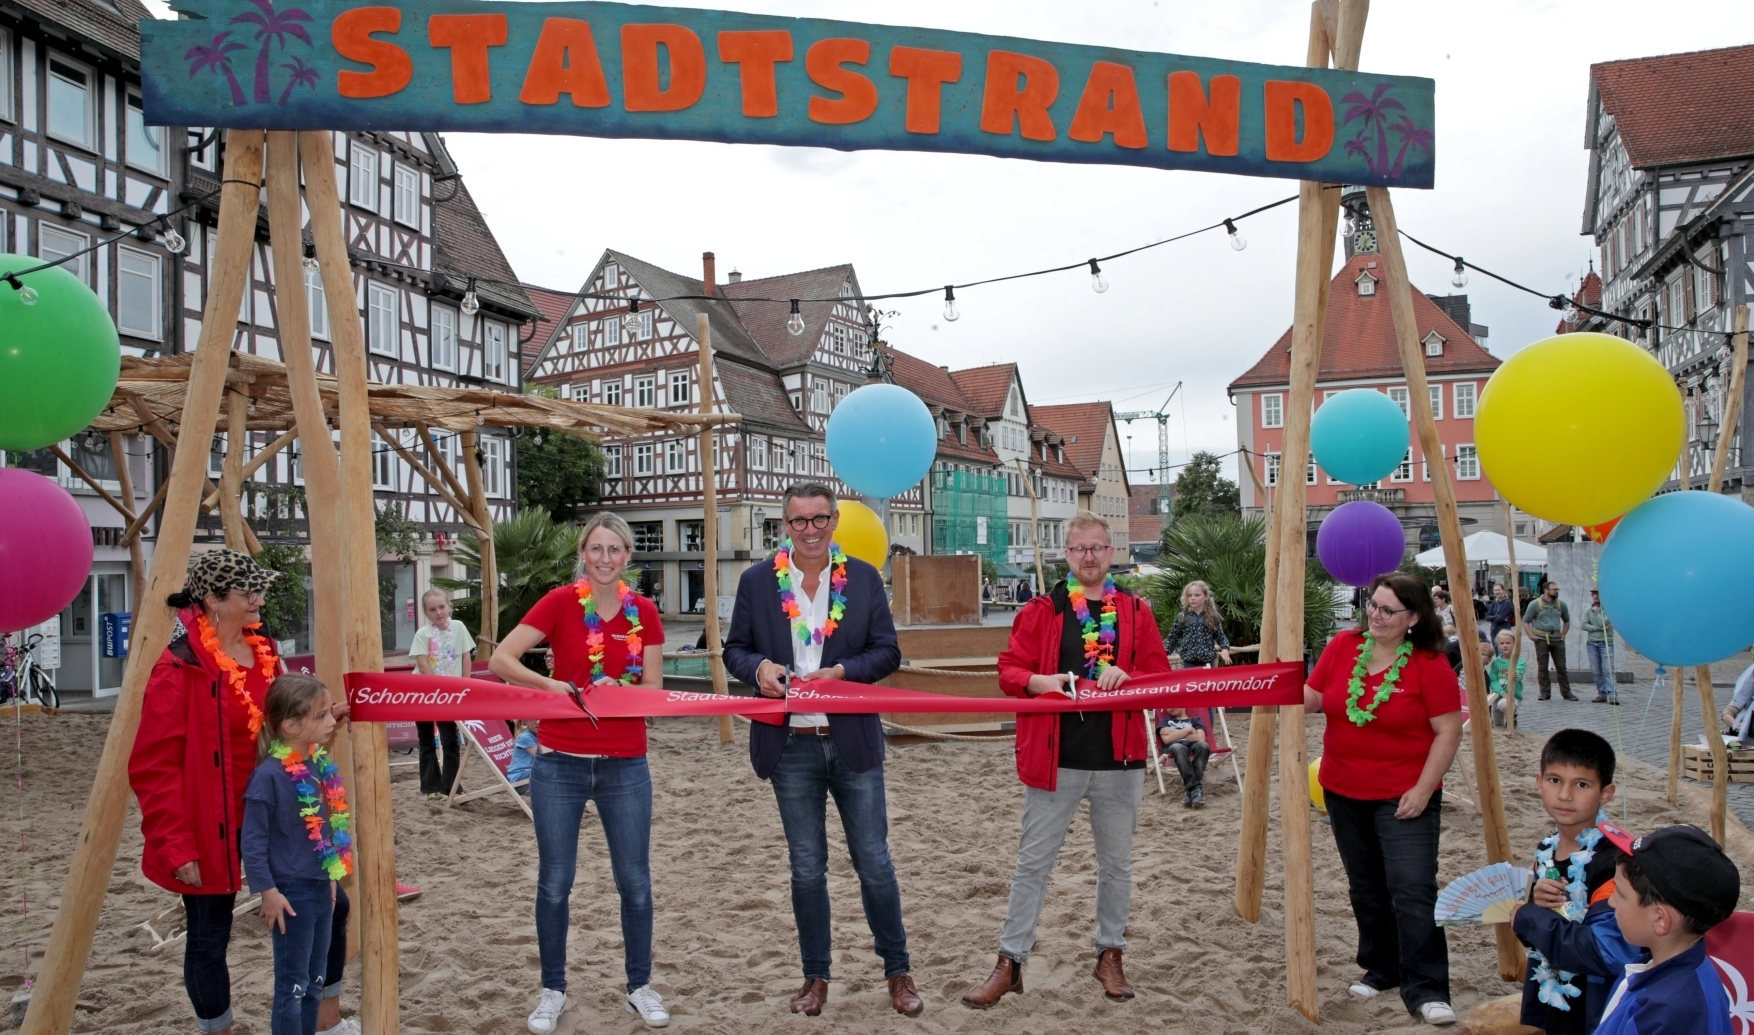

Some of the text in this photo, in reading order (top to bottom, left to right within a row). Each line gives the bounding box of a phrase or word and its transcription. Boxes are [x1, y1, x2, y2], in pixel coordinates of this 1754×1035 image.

[331, 6, 1335, 163] STADTSTRAND
[106, 620, 114, 656] BWPOST
[355, 687, 471, 704] Schorndorf
[1080, 675, 1278, 699] Stadtstrand Schorndorf
